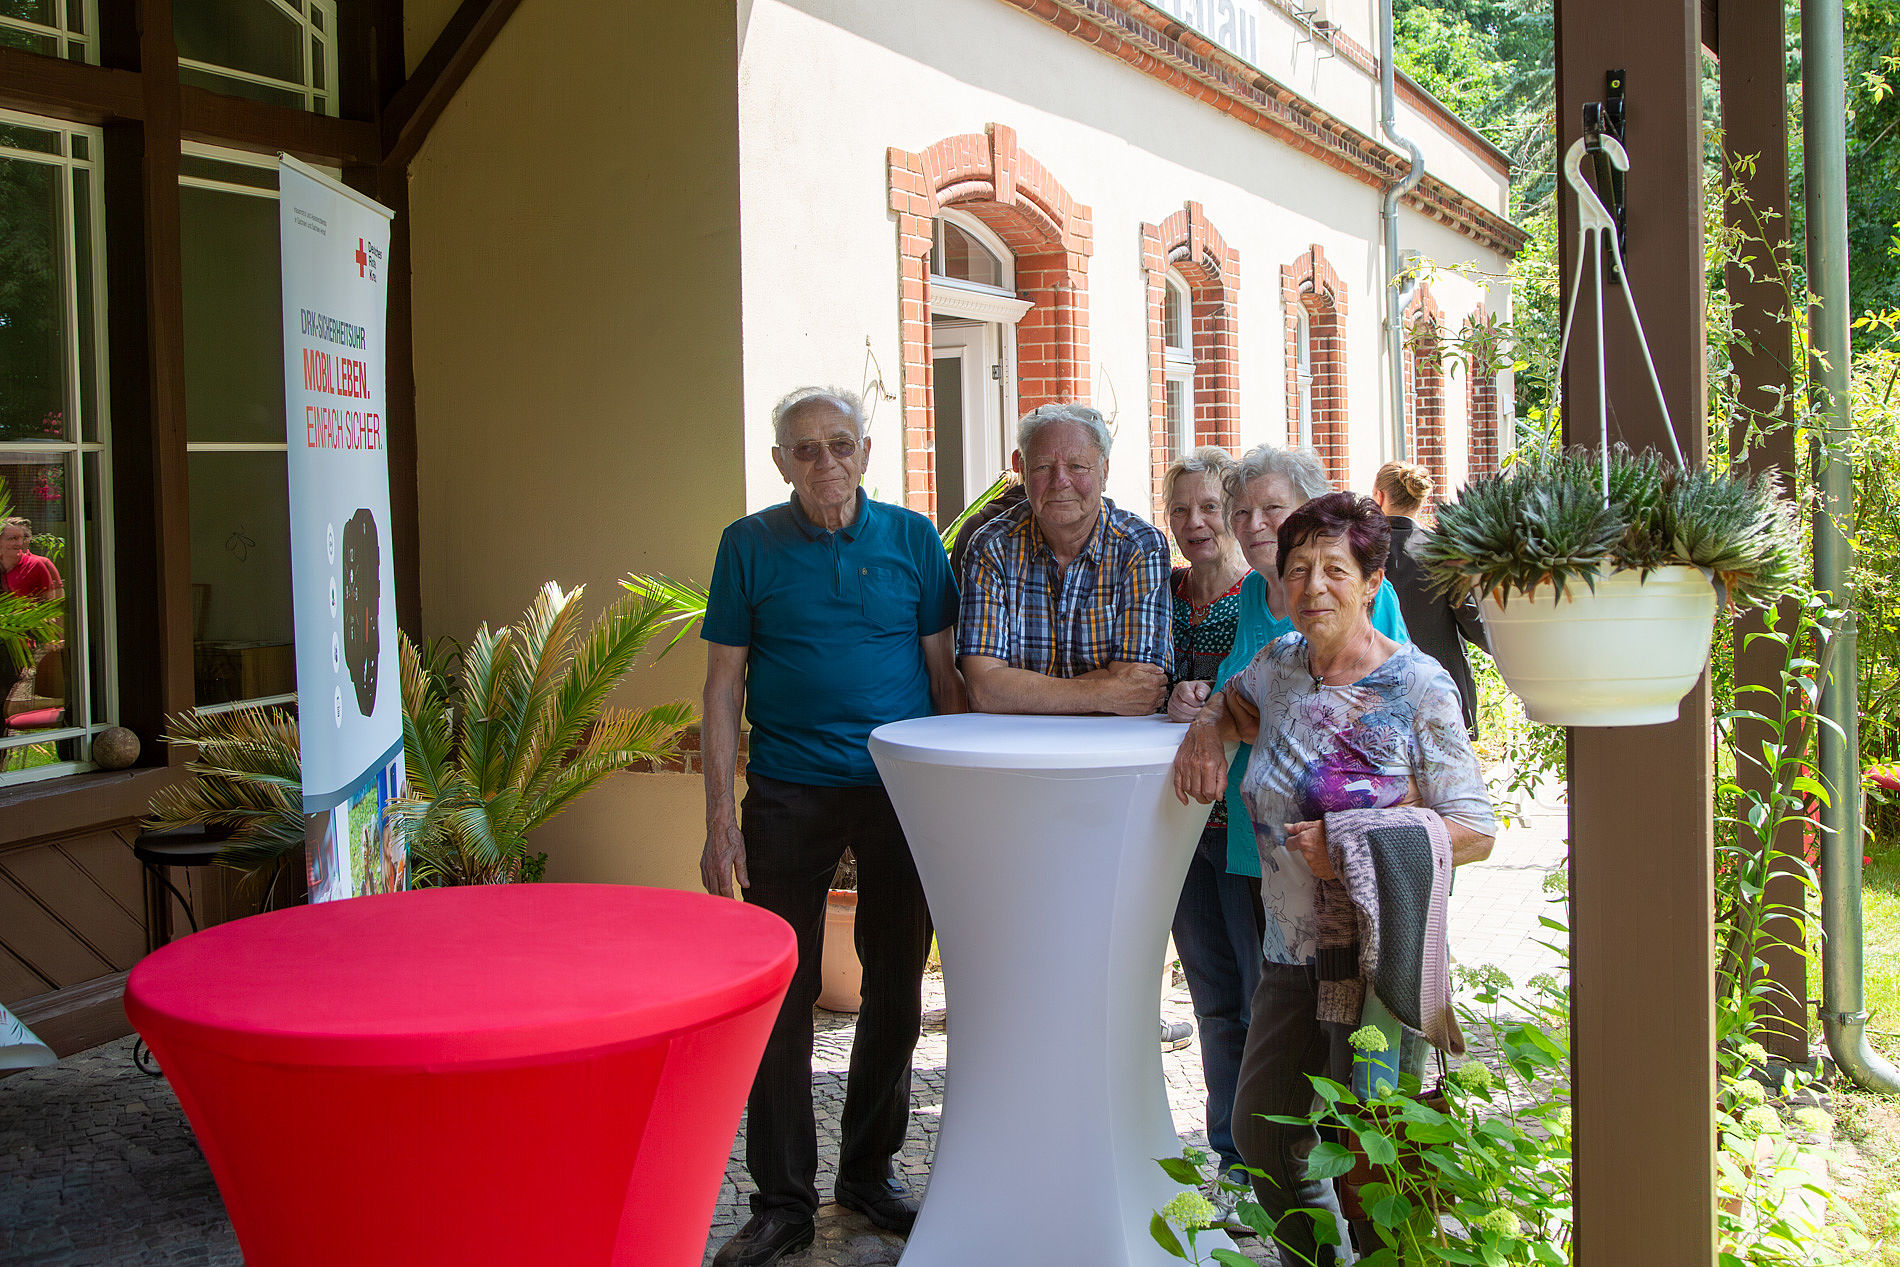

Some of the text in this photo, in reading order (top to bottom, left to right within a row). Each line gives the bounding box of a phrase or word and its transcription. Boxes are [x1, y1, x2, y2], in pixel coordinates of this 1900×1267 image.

[300, 308, 366, 350] DRK-SICHERHEITSUHR
[302, 347, 370, 399] MOBIL LEBEN.
[306, 406, 383, 450] EINFACH SICHER.
